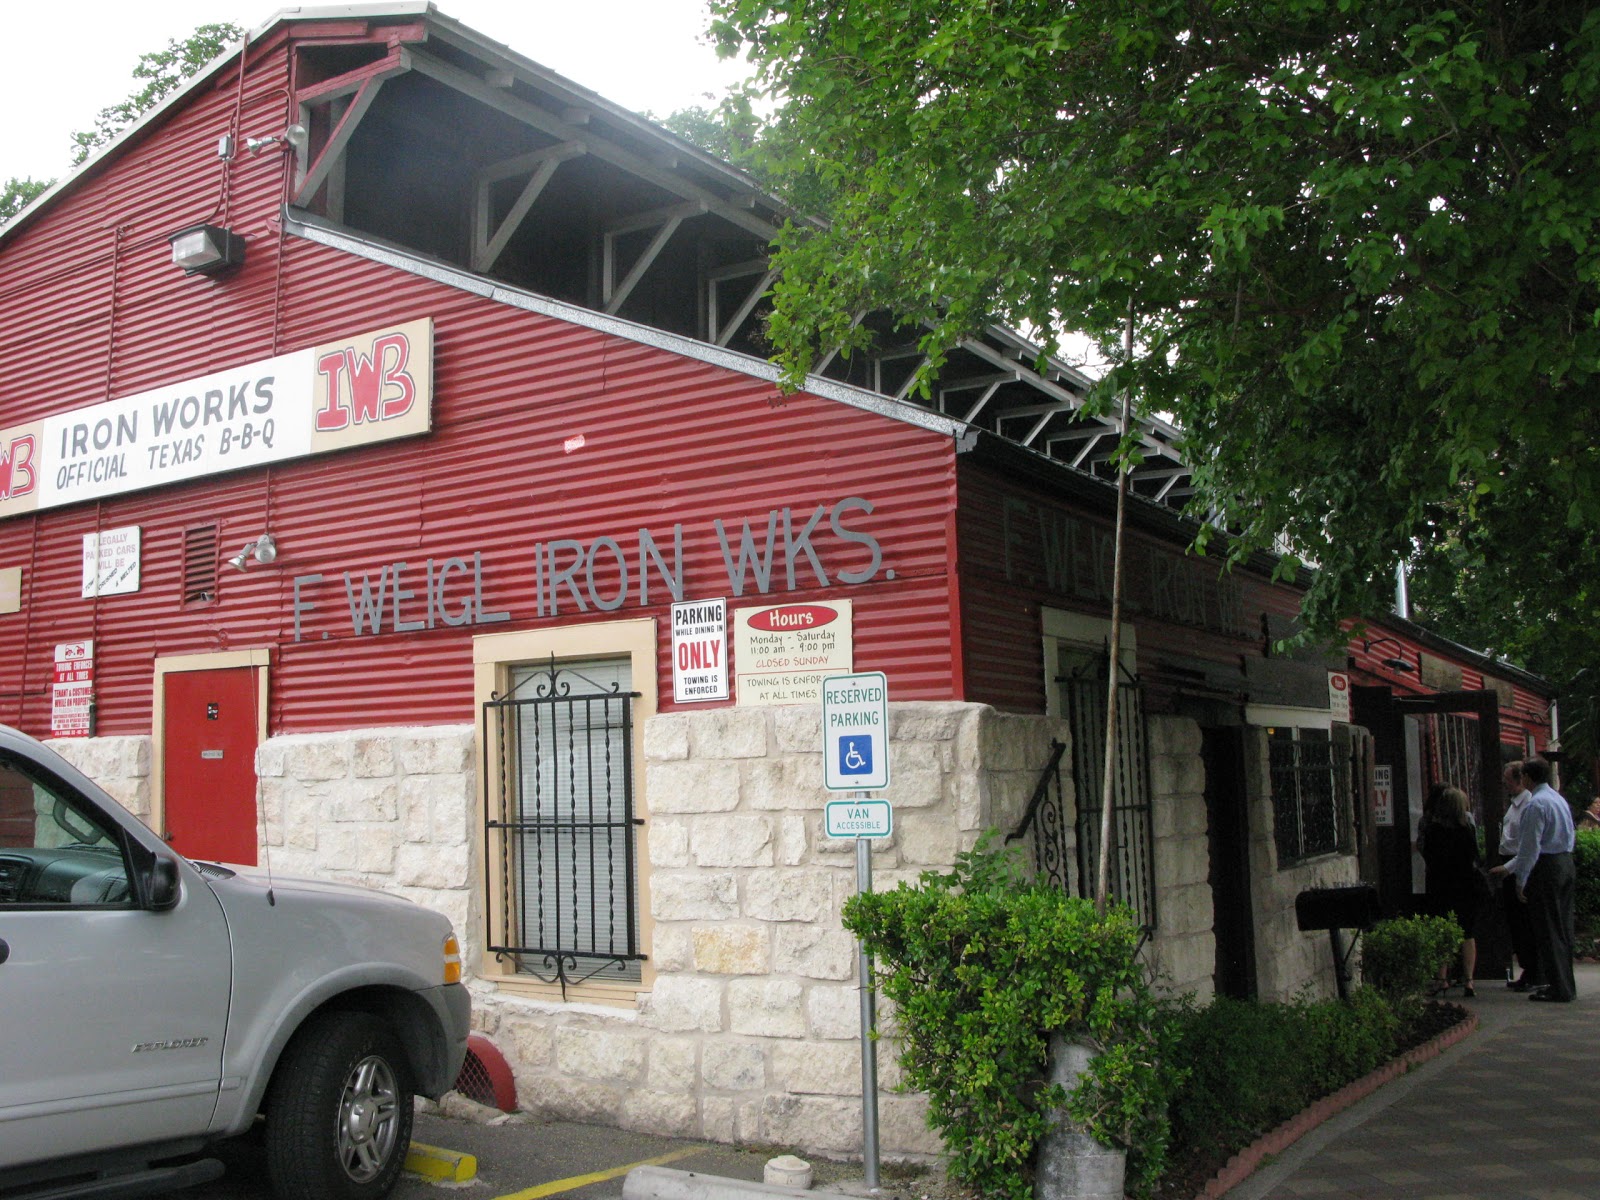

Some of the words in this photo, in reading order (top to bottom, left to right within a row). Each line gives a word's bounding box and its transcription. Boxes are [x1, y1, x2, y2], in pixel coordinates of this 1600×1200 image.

[314, 332, 417, 433] IWB
[60, 409, 138, 459] IRON
[152, 376, 275, 437] WORKS
[56, 452, 128, 491] OFFICIAL
[147, 434, 205, 471] TEXAS
[218, 418, 275, 456] B-B-Q
[92, 533, 128, 548] ILEGALLY
[85, 548, 114, 560] PAKED
[116, 544, 136, 556] CARS
[115, 558, 125, 568] BE
[294, 573, 330, 642] F.
[343, 551, 510, 636] WEIGL
[535, 523, 683, 617] IRON
[713, 496, 895, 597] WKS.
[675, 604, 722, 626] PARKING
[769, 610, 814, 627] Hours
[675, 627, 693, 636] WHILE
[695, 625, 715, 635] DINING
[716, 624, 723, 632] IN
[750, 635, 783, 645] Monday
[796, 631, 836, 643] Saturday
[678, 639, 721, 671] ONLY
[750, 646, 770, 655] 11:00
[799, 643, 820, 652] 9:00
[822, 642, 835, 652] pm
[755, 657, 790, 668] CLOSED
[793, 655, 829, 667] SUNDAY
[59, 673, 65, 682] AT
[66, 672, 74, 681] ALL
[684, 676, 709, 685] TOWING
[711, 674, 718, 682] IS
[747, 677, 779, 686] TOWING
[782, 676, 790, 685] IS
[793, 675, 828, 685] ENFOR
[684, 685, 718, 695] ENFORCED
[759, 691, 769, 700] AT
[772, 690, 787, 700] ALL
[791, 689, 817, 699] TIMES
[826, 687, 882, 705] RESERVED
[830, 711, 879, 727] PARKING
[847, 808, 869, 819] VAN
[836, 821, 881, 830] ACCESSIBLE
